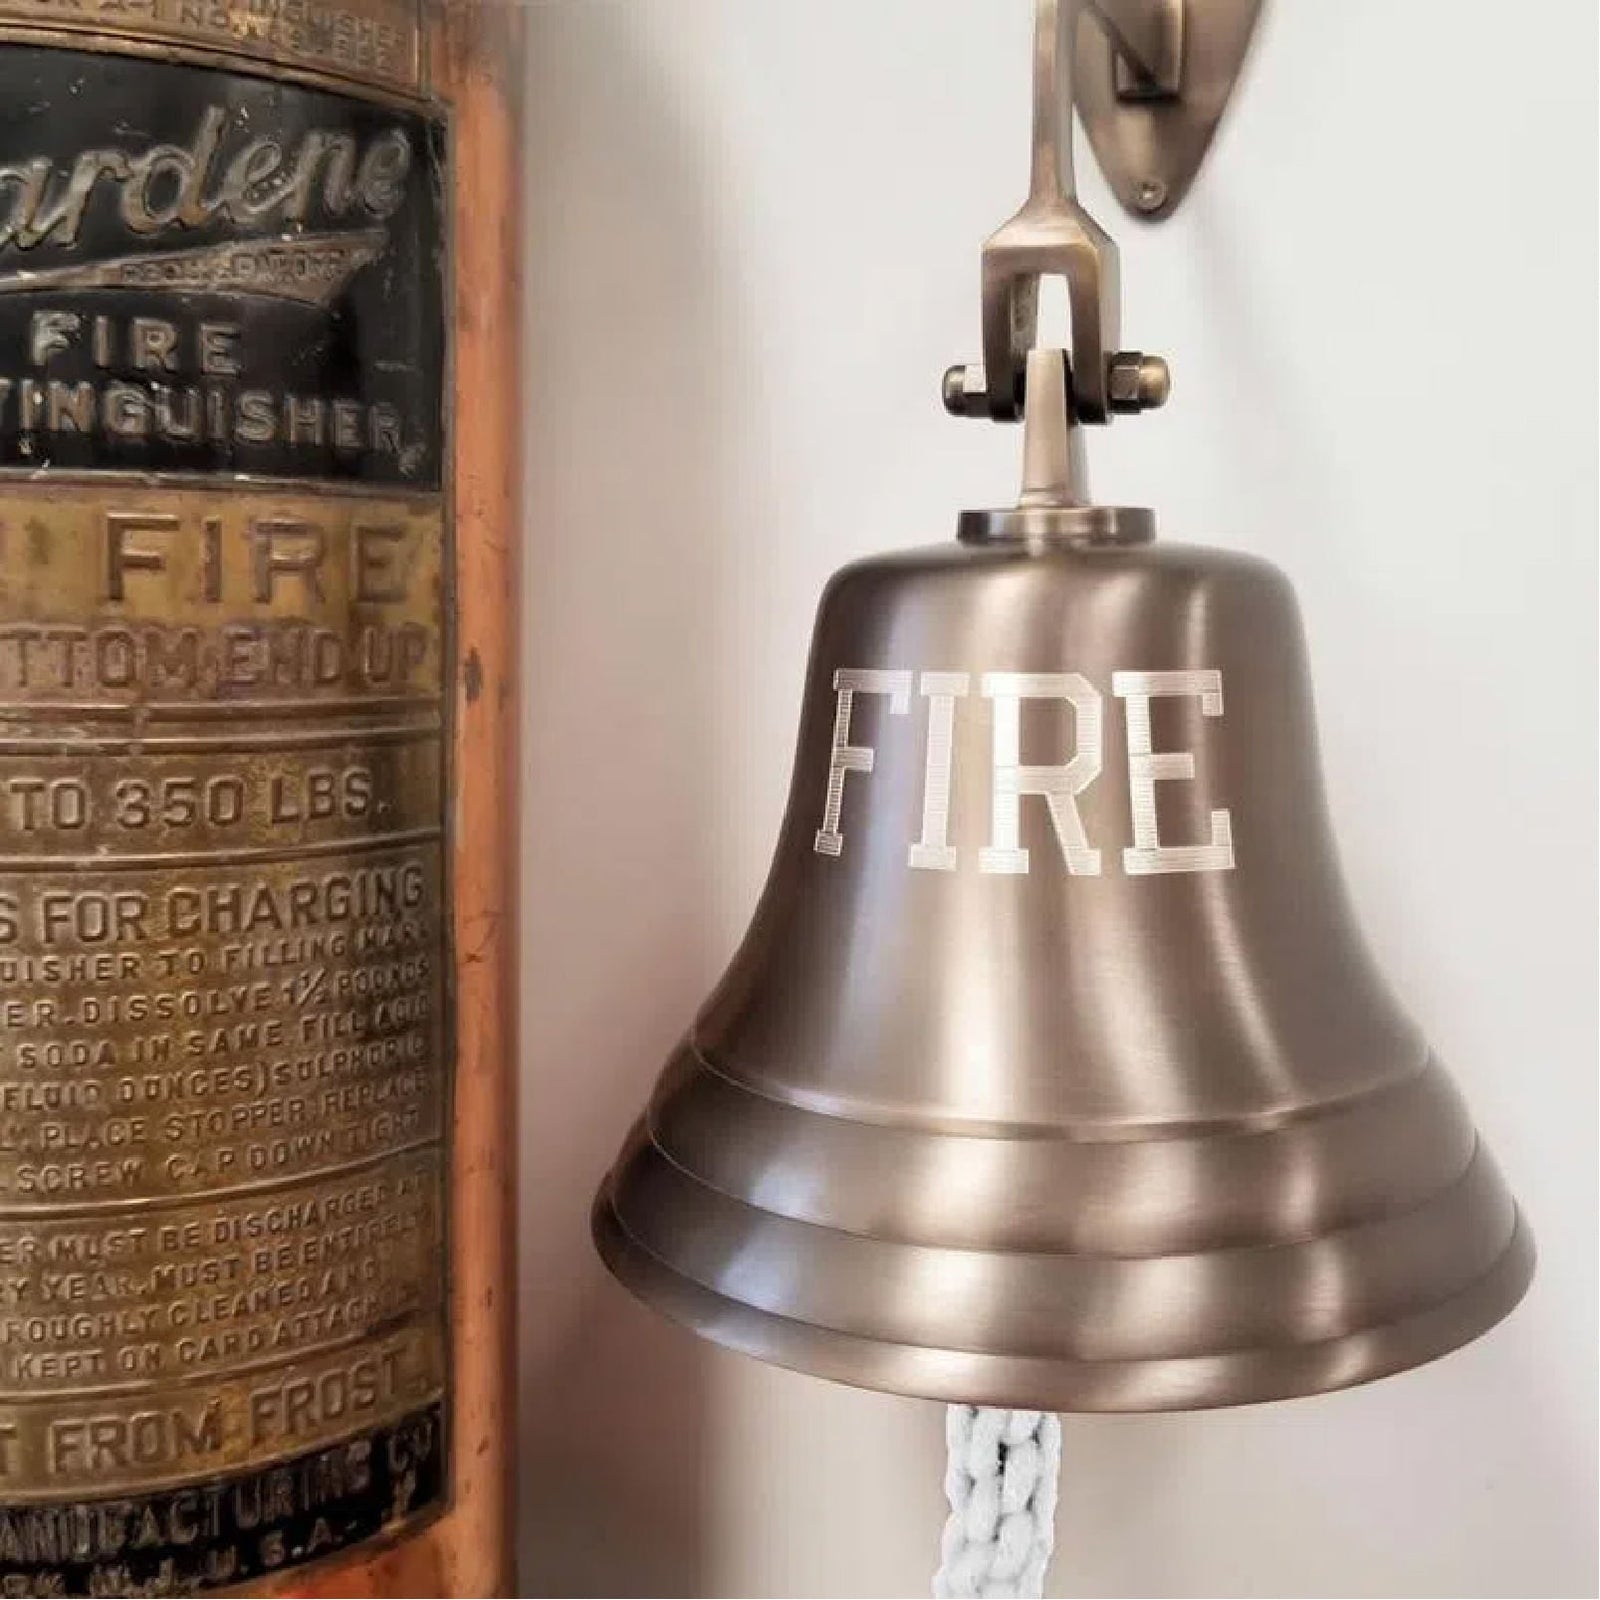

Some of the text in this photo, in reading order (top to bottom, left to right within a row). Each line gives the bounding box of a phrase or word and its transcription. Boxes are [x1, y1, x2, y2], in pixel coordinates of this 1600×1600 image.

[29, 309, 242, 375] FIRE
[106, 512, 408, 605] FIRE
[221, 622, 343, 687] END
[362, 622, 427, 685] UP
[9, 765, 391, 831] TO 350 LBS.
[814, 669, 1236, 876] FIRE
[40, 890, 148, 944] FOR
[166, 861, 424, 941] CHARGING
[156, 948, 206, 976] TO
[223, 929, 346, 969] FILLING
[17, 1039, 117, 1070] SODA
[133, 1034, 171, 1063] IN
[186, 1020, 284, 1057] SAME
[302, 1009, 365, 1044] FILL
[0, 1080, 100, 1112] FLUID
[17, 1156, 142, 1195] SCREW
[165, 1147, 236, 1184] CAP
[248, 1130, 334, 1173] DOWN
[41, 1115, 147, 1151] PLACE
[49, 1228, 147, 1262] MUST
[160, 1222, 201, 1255] BE
[214, 1184, 386, 1245] DISCHARGED
[151, 1256, 240, 1291] MUST
[253, 1245, 294, 1275] BE
[168, 1276, 310, 1329] CLEANED
[12, 1348, 104, 1380] KEPT
[117, 1342, 161, 1374] ON
[175, 1325, 265, 1366] CARD
[47, 1398, 224, 1475] FROM
